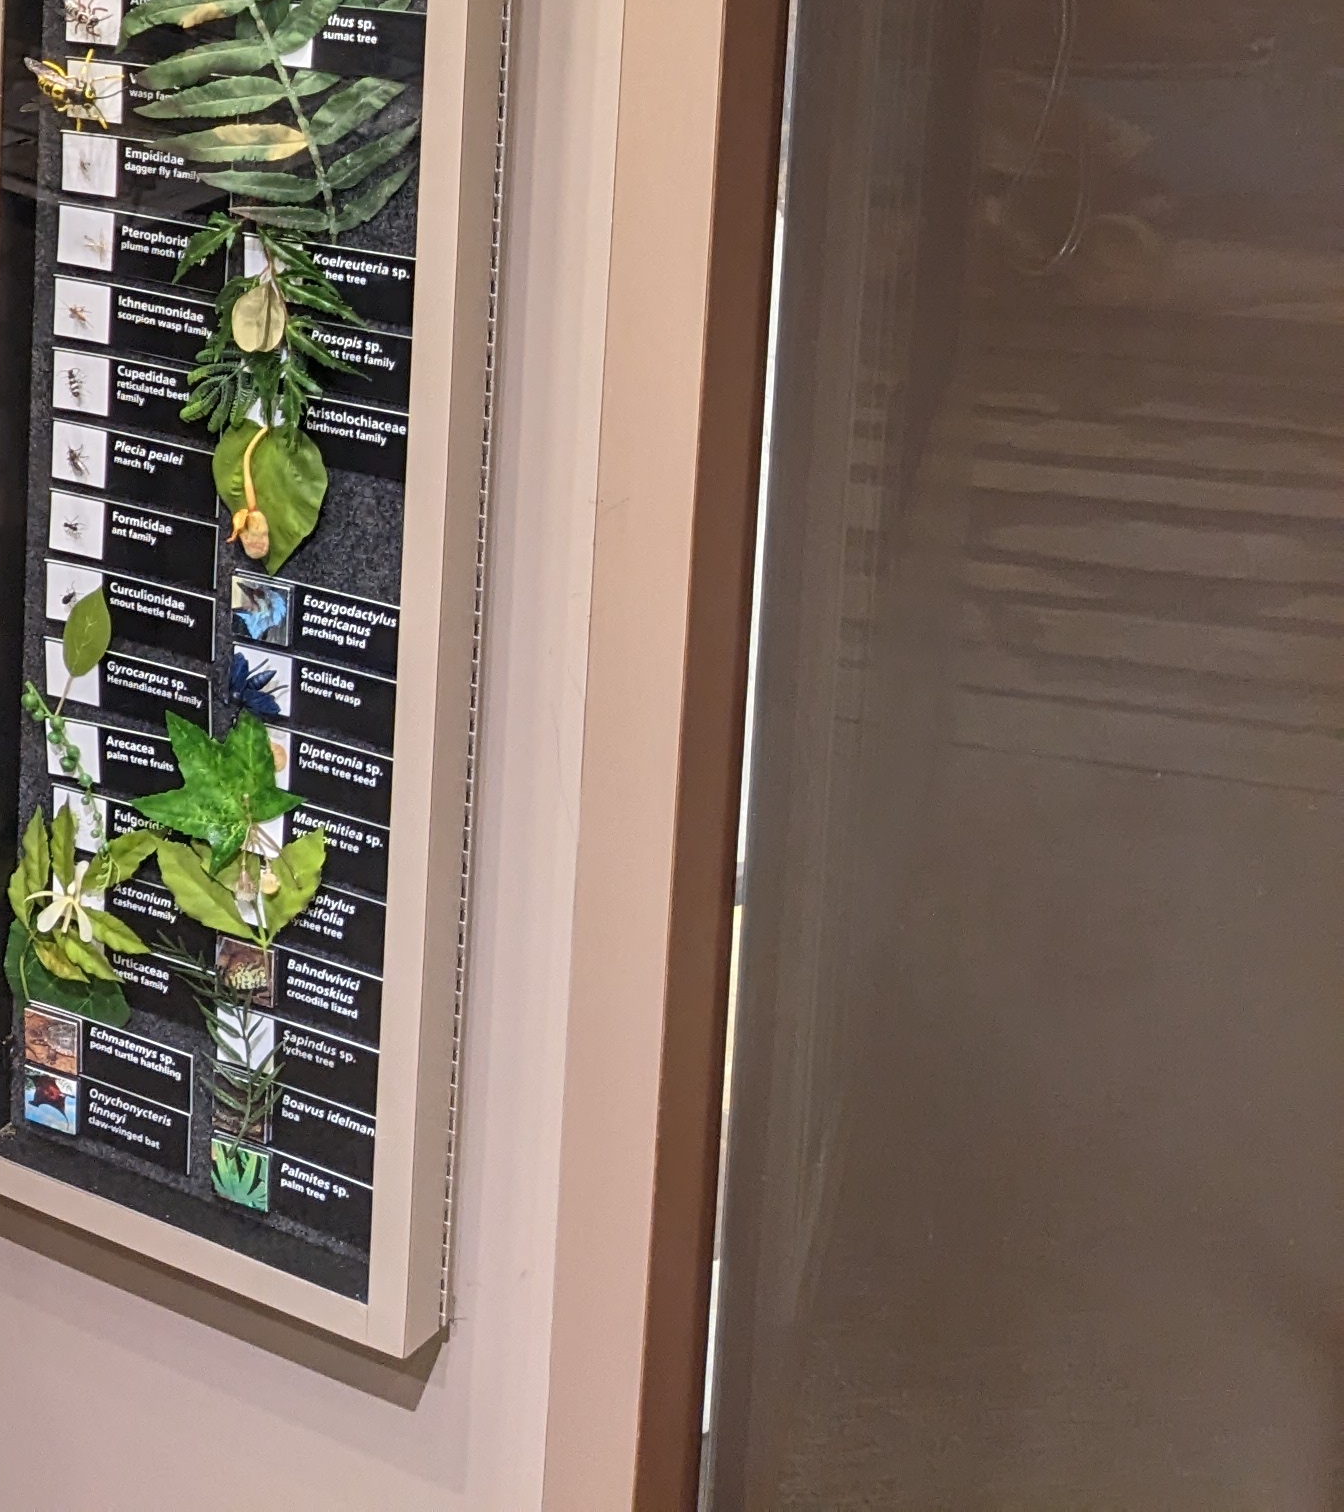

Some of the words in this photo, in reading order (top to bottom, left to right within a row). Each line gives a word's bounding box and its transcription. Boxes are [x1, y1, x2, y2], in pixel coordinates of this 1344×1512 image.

[357, 18, 376, 32] sp.
[323, 31, 354, 42] sumac
[357, 35, 378, 45] tree
[130, 89, 153, 101] wasp
[125, 147, 184, 165] Empididae
[125, 162, 156, 175] dagger
[159, 166, 171, 179] fly
[121, 241, 149, 254] plume
[151, 246, 175, 258] moth
[313, 253, 389, 276] Koelreuteria
[392, 267, 410, 280] sp.
[347, 274, 367, 285] tree
[118, 295, 204, 322] Ichneumonidae
[118, 311, 155, 327] scorpion
[158, 319, 182, 332] wasp
[184, 323, 212, 339] family
[311, 330, 362, 349] Prosopis
[365, 341, 383, 354] sp.
[342, 350, 362, 363] tree
[364, 354, 395, 371] family
[117, 365, 176, 386] Cupedidae
[117, 392, 145, 406] family
[356, 430, 387, 447] family
[114, 440, 146, 457] Plecia
[148, 452, 183, 466] pealei
[114, 455, 141, 469] march
[144, 460, 155, 473] fly
[112, 511, 172, 535] Formicidae
[112, 526, 127, 537] ant
[129, 530, 157, 546] family
[110, 597, 135, 611] snout
[137, 602, 164, 618] beetle
[167, 610, 195, 628] family
[303, 612, 371, 637] americanus
[302, 626, 344, 645] perching
[346, 635, 366, 649] bird
[107, 661, 169, 685] Gyrocarpus
[171, 677, 187, 690] sp.
[301, 668, 355, 691] Scoliidae
[174, 691, 202, 708] family
[300, 681, 332, 699] flower
[335, 691, 361, 707] wasp
[107, 750, 128, 763] palm
[130, 755, 149, 767] tree
[300, 743, 363, 770] Dipteronia
[365, 762, 383, 776] sp.
[298, 756, 330, 773] lychee
[332, 767, 351, 780] tree
[353, 772, 377, 787] seed
[340, 839, 359, 853] tree
[366, 833, 383, 848] sp.
[113, 897, 146, 914] cashew
[148, 906, 176, 924] family
[323, 926, 343, 940] tree
[141, 976, 168, 994] family
[287, 975, 354, 1005] ammoskius
[287, 989, 329, 1010] crocodile
[331, 1002, 358, 1019] lizard
[90, 1027, 158, 1060] Echmatemys
[160, 1051, 175, 1066] sp.
[90, 1040, 112, 1055] pond
[115, 1048, 139, 1064] turtle
[283, 1030, 336, 1056] Sapindus
[339, 1050, 356, 1063] sp.
[315, 1055, 334, 1068] tree
[282, 1094, 324, 1118] Boavus
[282, 1108, 300, 1122] boa
[145, 1136, 160, 1150] bat
[280, 1178, 304, 1193] palm
[306, 1187, 326, 1201] tree
[281, 1163, 330, 1190] Palmites
[333, 1184, 350, 1198] sp.
